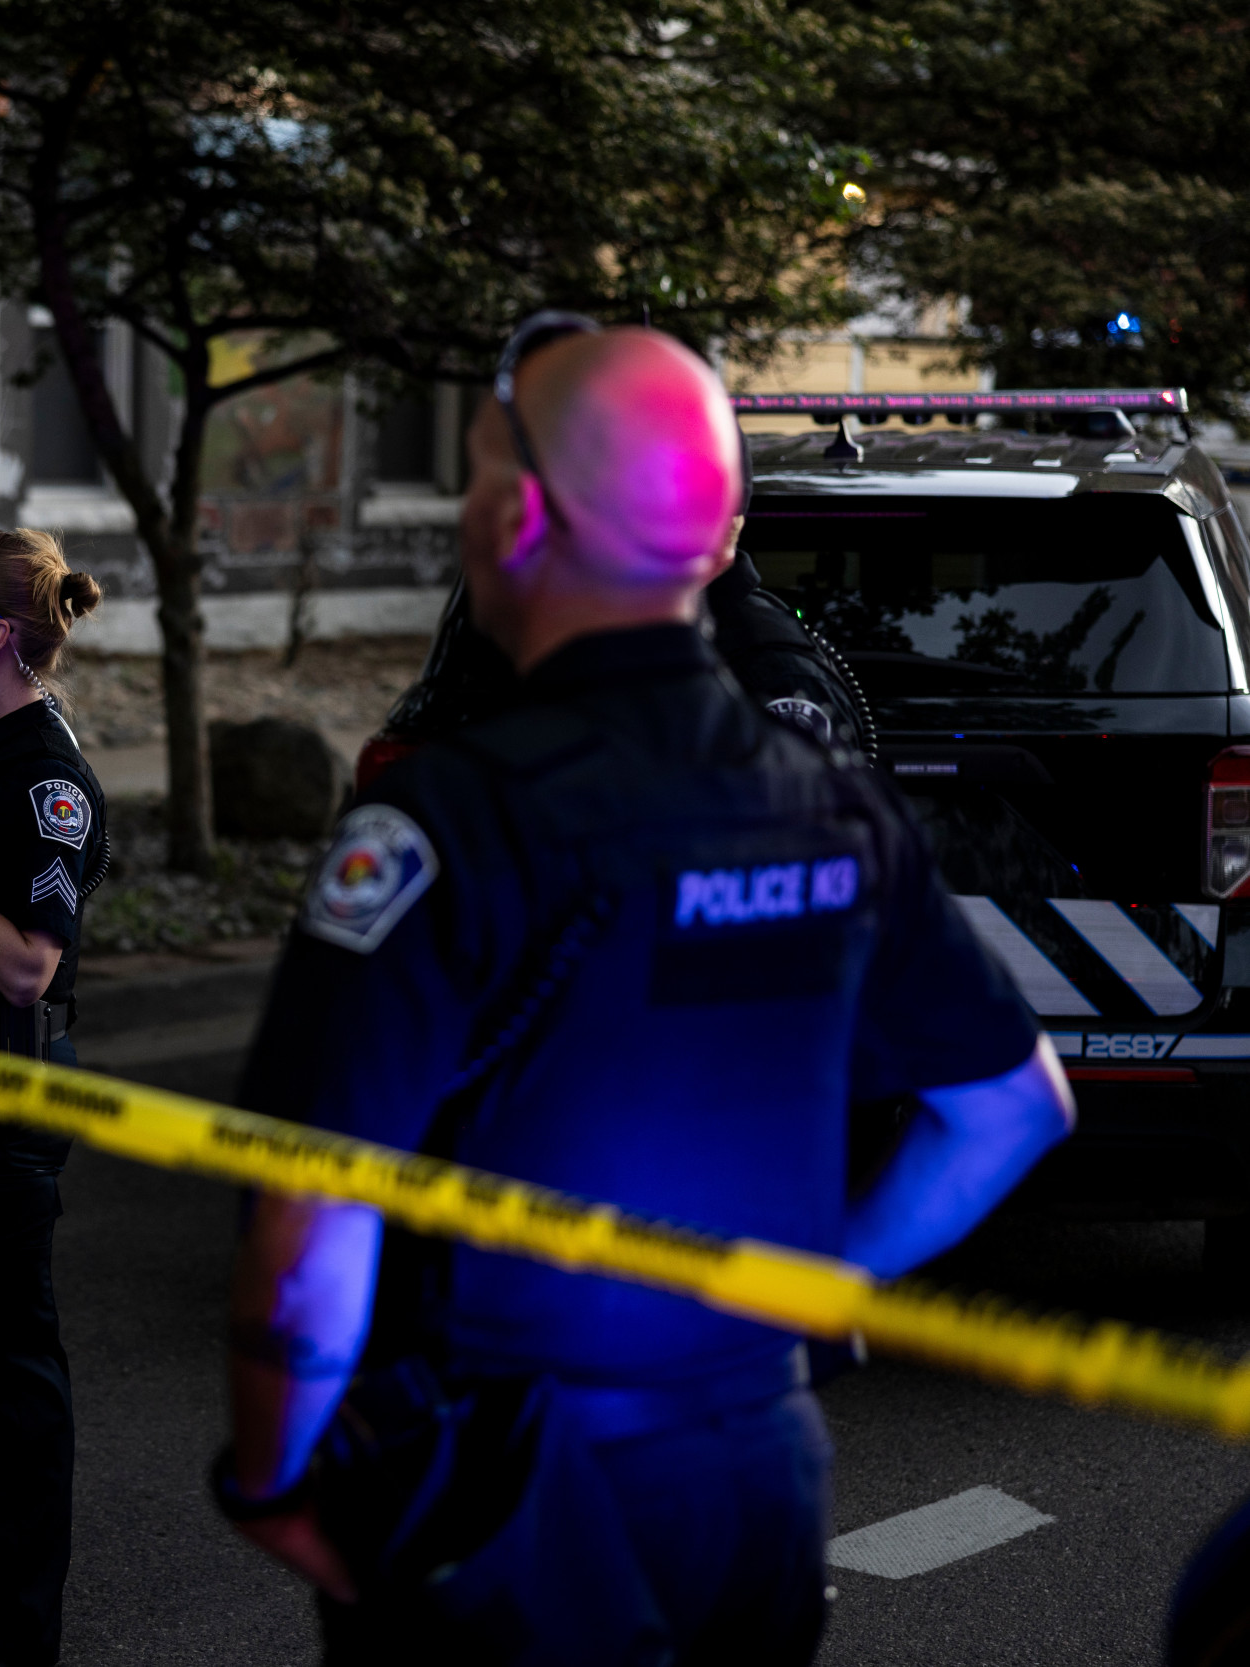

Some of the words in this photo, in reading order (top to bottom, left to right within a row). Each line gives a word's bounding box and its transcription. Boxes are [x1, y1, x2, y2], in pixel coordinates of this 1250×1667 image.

[45, 782, 84, 803] POLICE
[676, 867, 806, 926] POLICE
[1086, 1033, 1179, 1059] 2687
